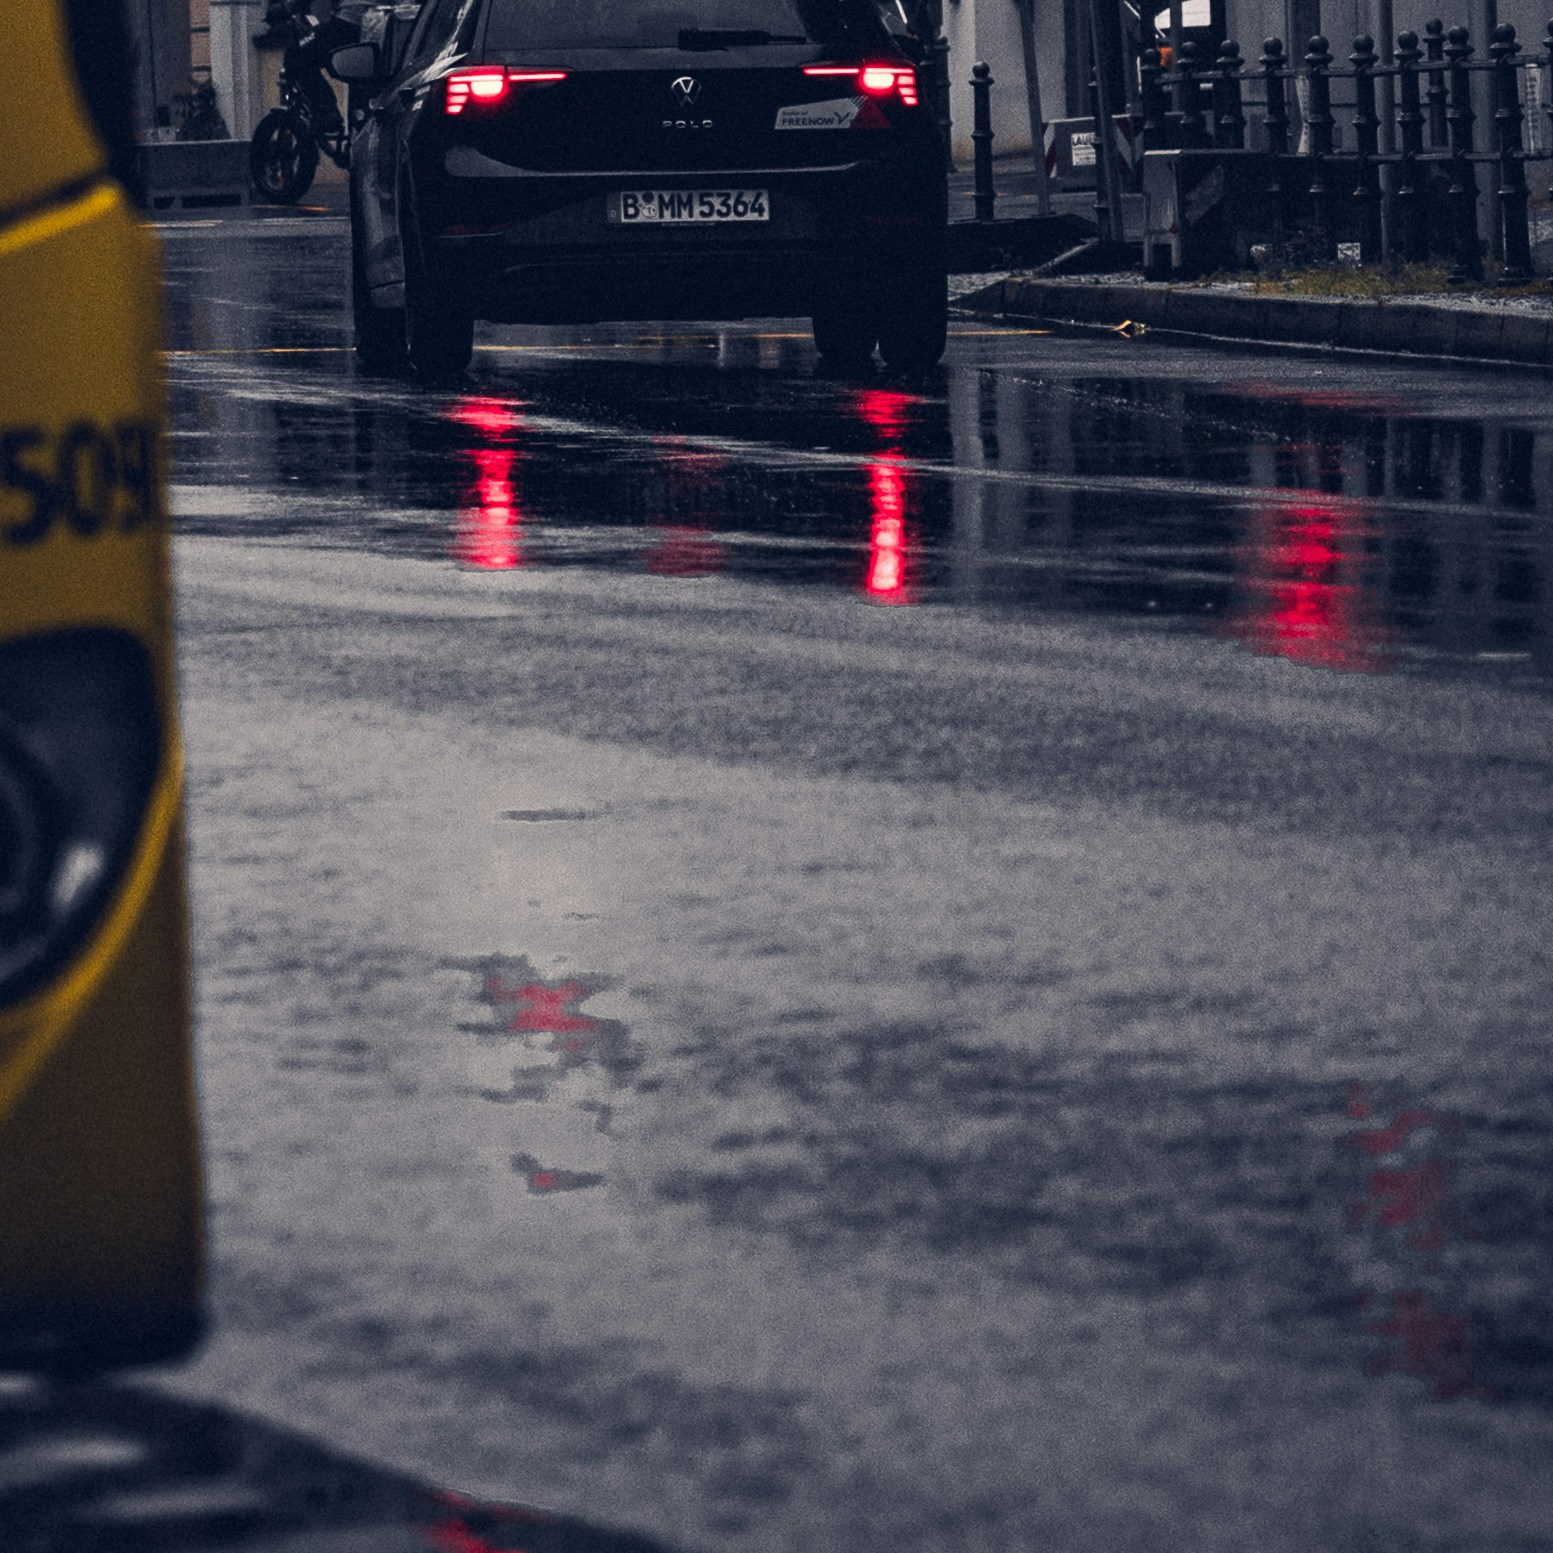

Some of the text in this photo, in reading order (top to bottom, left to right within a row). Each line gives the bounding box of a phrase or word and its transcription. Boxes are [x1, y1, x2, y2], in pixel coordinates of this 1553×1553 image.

[662, 119, 713, 129] POLO
[781, 117, 835, 126] FREENOW
[623, 194, 640, 219] B
[698, 192, 766, 217] 5364
